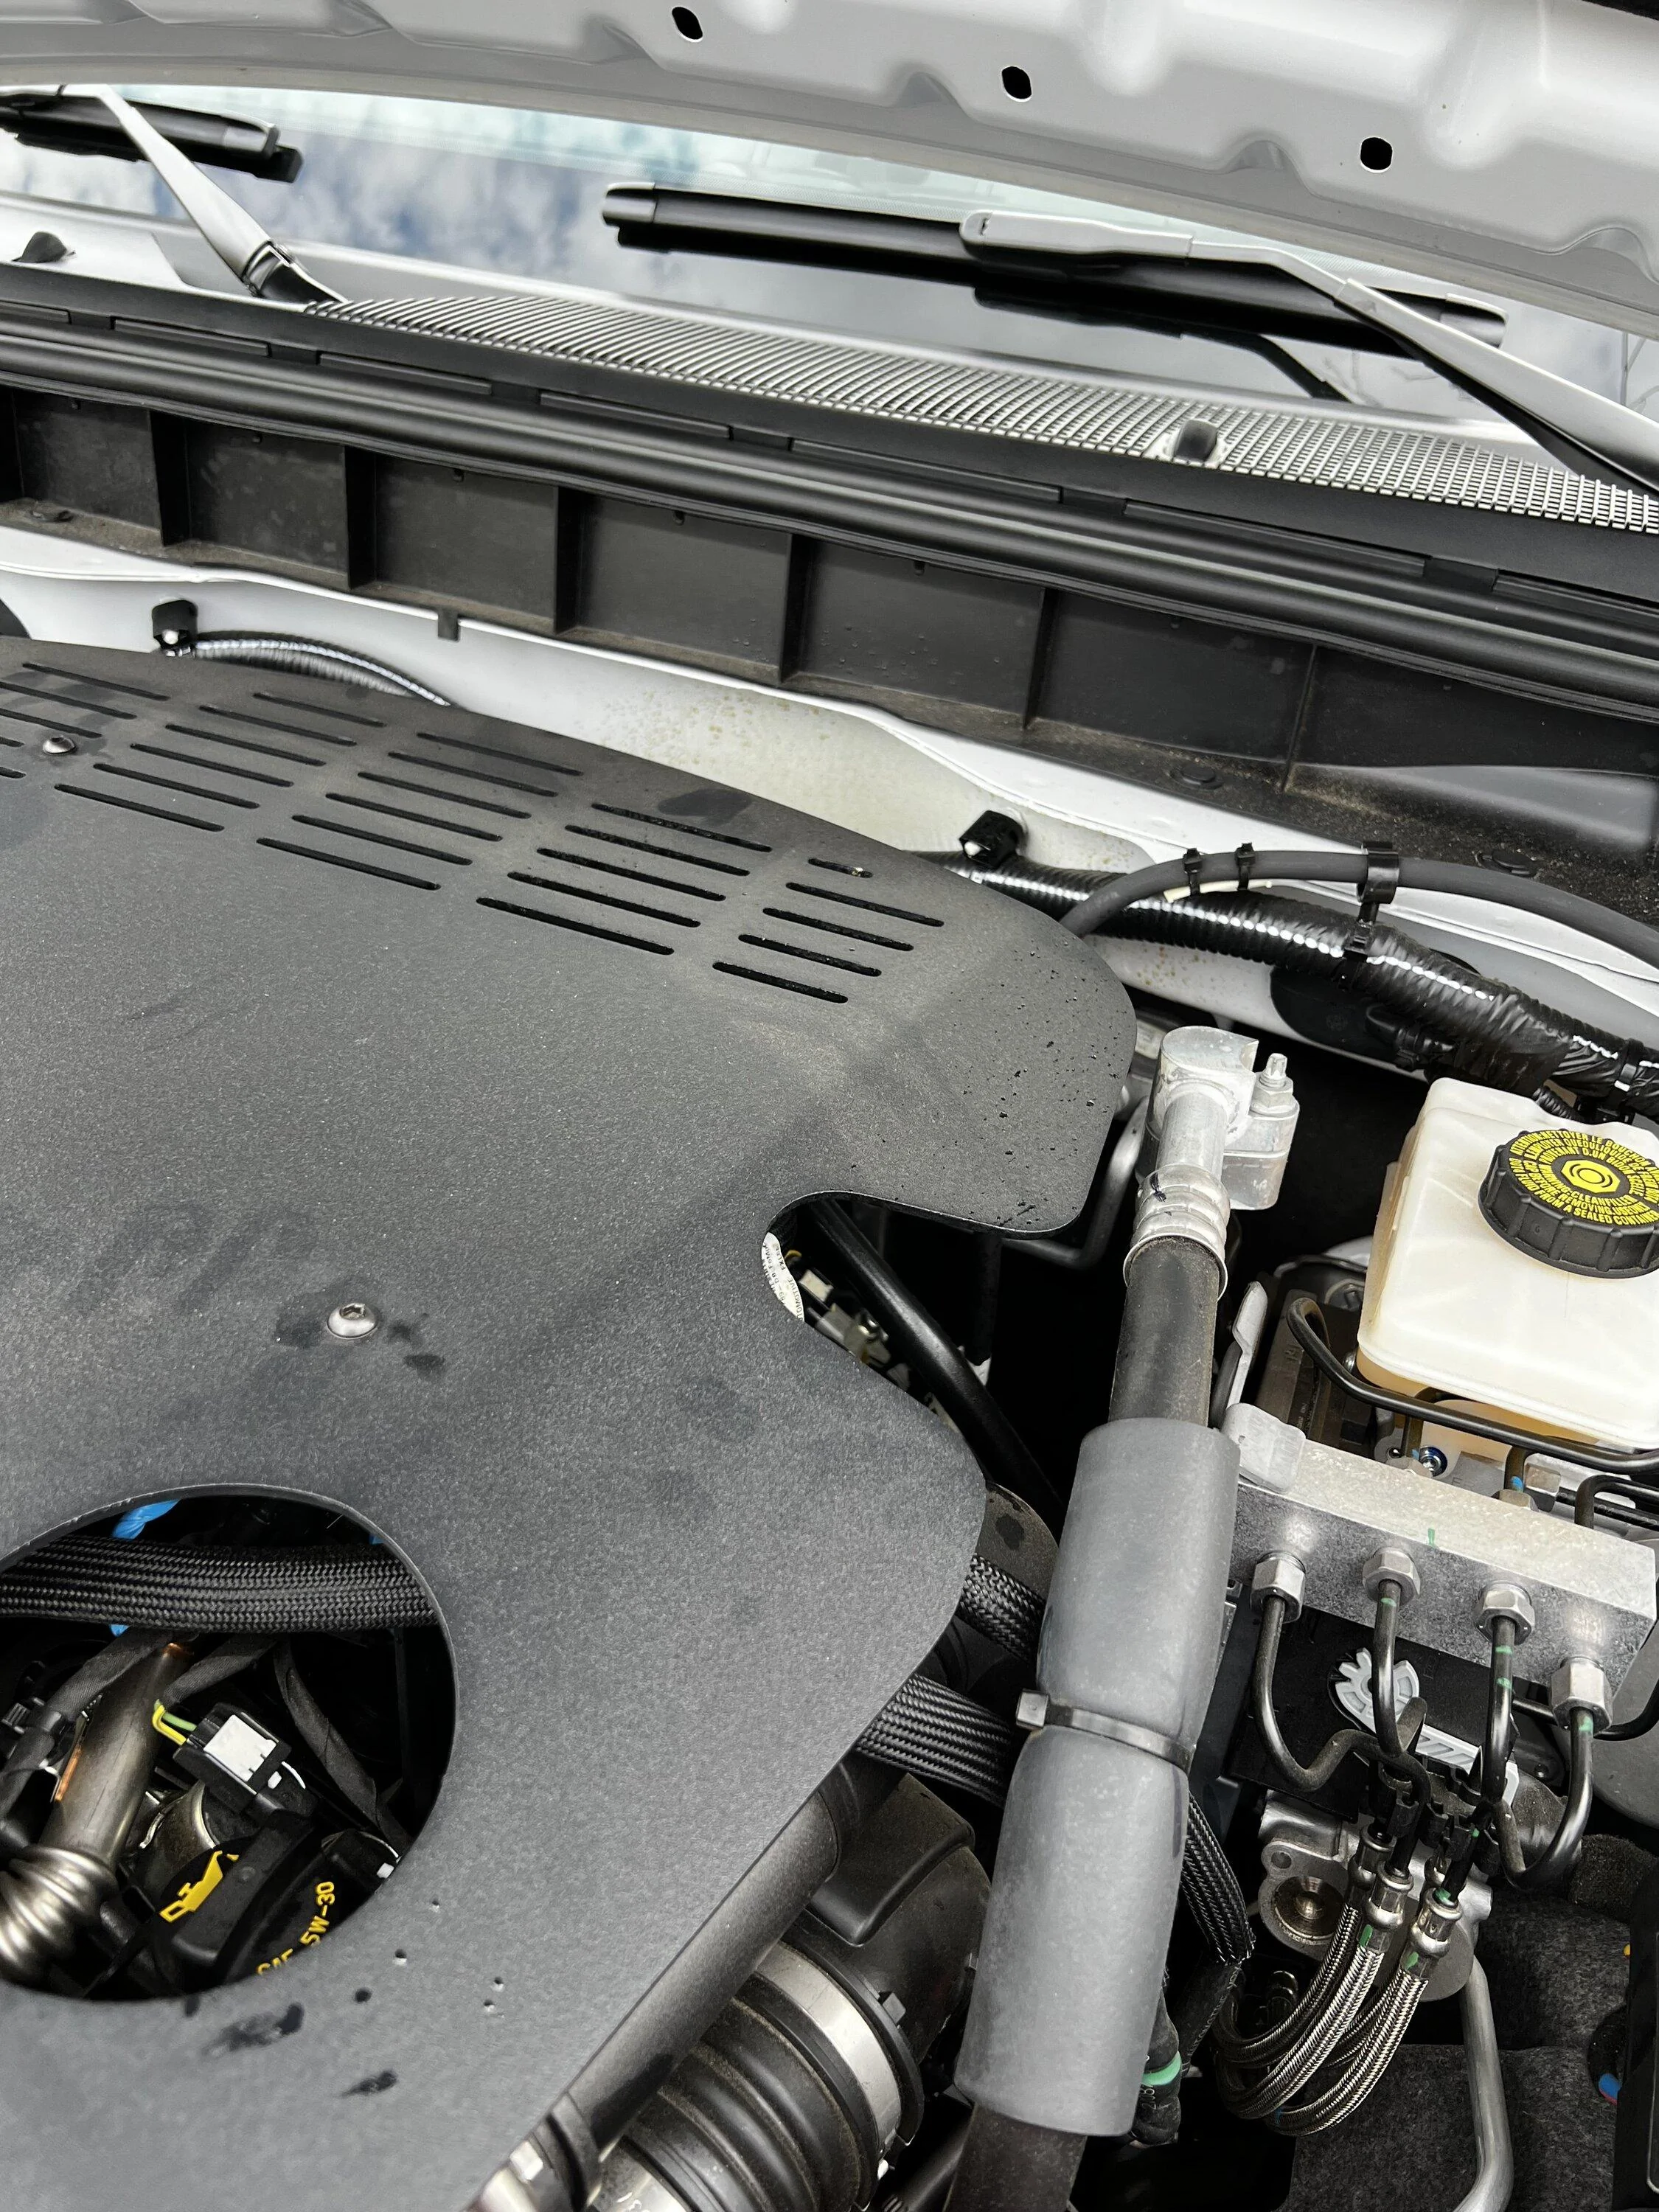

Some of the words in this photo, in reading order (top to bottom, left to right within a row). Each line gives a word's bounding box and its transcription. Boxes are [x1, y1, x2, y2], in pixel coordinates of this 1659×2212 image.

[1538, 1146, 1579, 1165] PROVENANT
[1606, 1155, 1636, 1175] BIDON
[1591, 1135, 1603, 1145] LE
[1605, 1140, 1652, 1166] BOUCHON
[1523, 1160, 1540, 1172] CAP
[1515, 1173, 1540, 1192] FLUID
[1534, 1189, 1565, 1208] FROM
[1563, 1204, 1572, 1213] A
[1573, 1207, 1613, 1224] SEALED
[1613, 1210, 1659, 1225] CONTAINER
[1528, 1172, 1561, 1196] BEFORE
[299, 1881, 335, 1947] 5W-30
